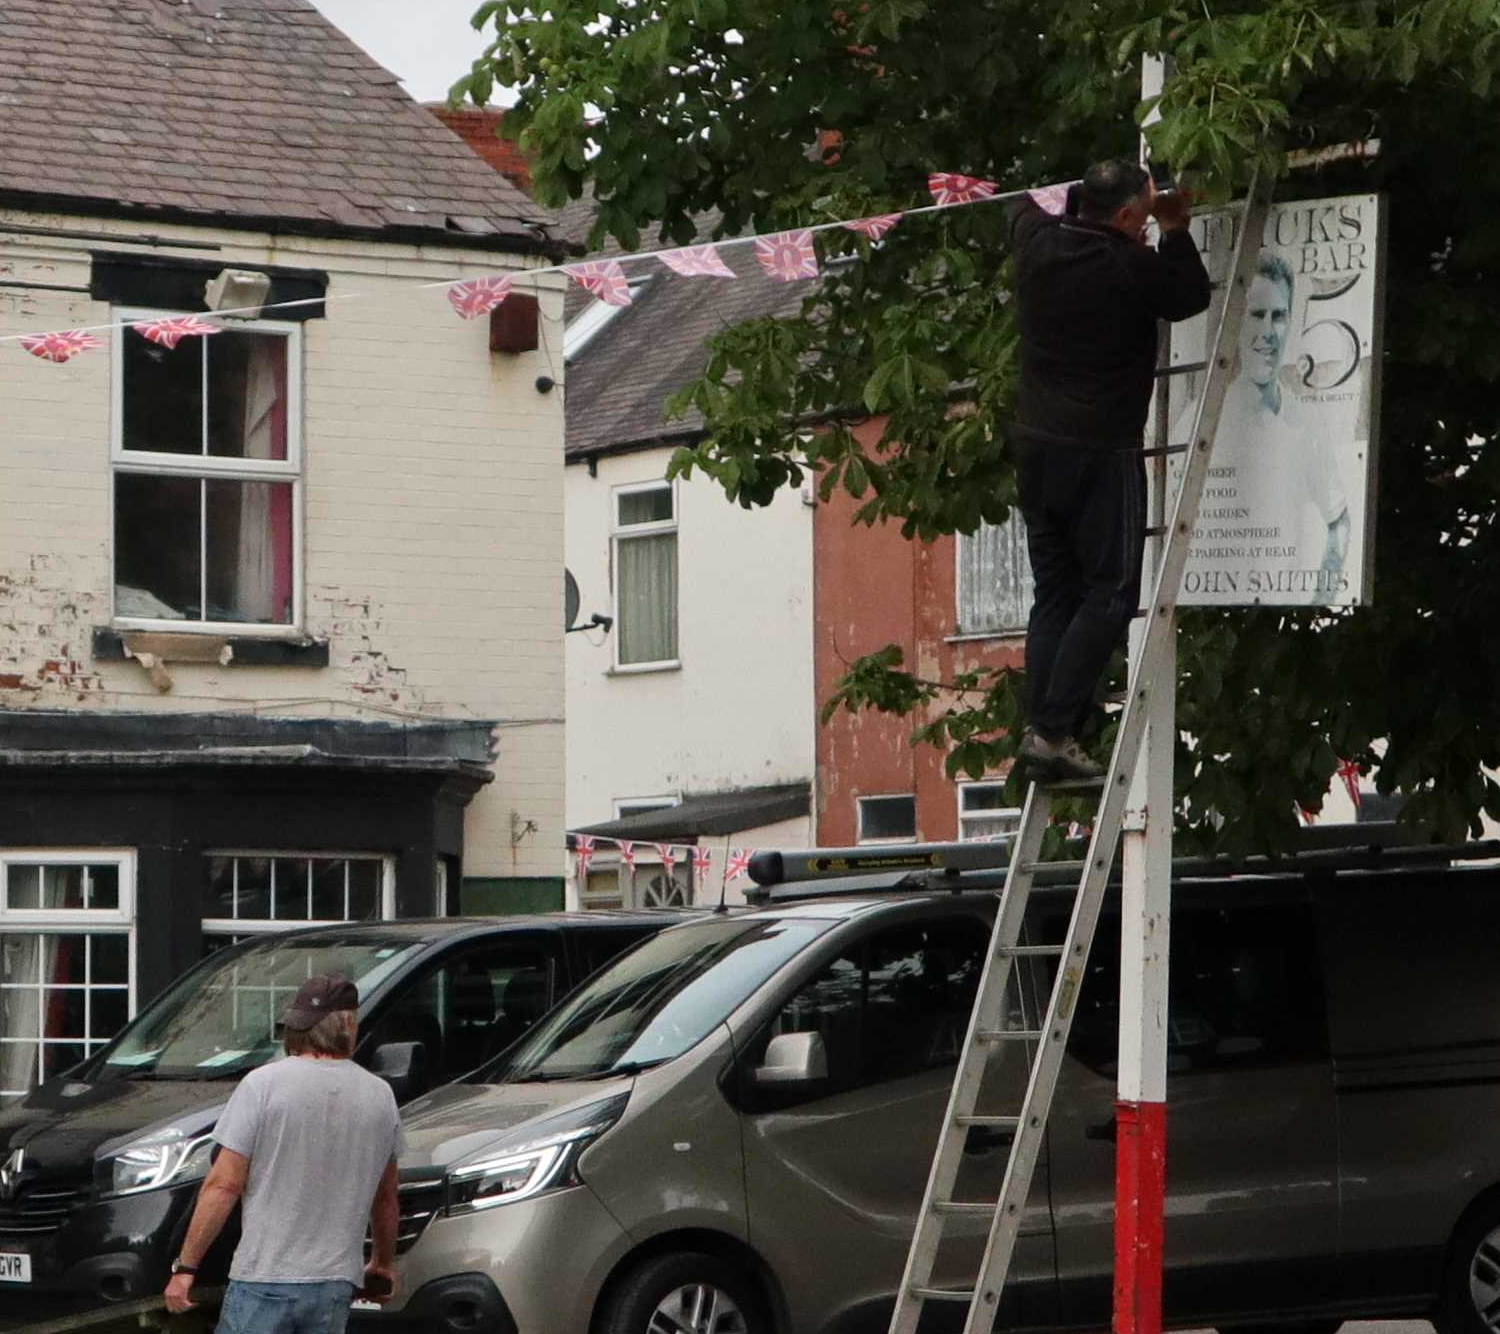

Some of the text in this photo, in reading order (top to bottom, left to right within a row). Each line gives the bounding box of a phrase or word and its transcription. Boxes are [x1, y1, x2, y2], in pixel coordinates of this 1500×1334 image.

[1299, 241, 1368, 274] BAR
[1301, 271, 1362, 391] 5
[1205, 487, 1238, 499] FOOD
[1202, 507, 1250, 520] GARDEN
[1207, 527, 1281, 540] ATMOSPHERE
[1195, 546, 1297, 559] PARKING AT REAR
[1184, 568, 1349, 594] OHN SMITHS
